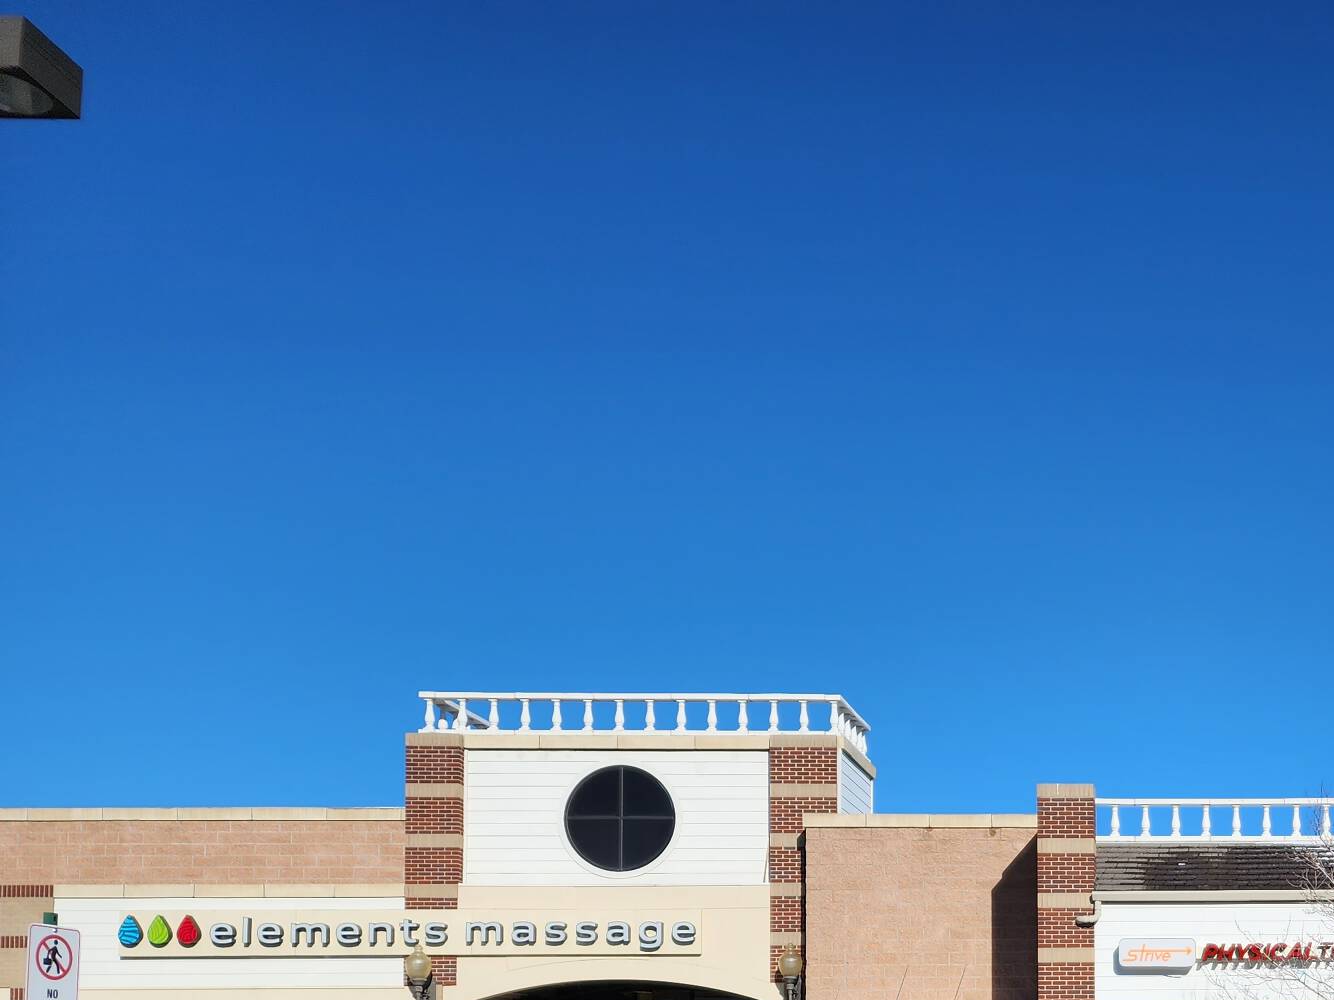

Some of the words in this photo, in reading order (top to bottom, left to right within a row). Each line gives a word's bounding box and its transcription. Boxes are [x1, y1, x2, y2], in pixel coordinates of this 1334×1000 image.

[209, 917, 449, 948] elements
[465, 921, 697, 952] massage
[1122, 944, 1175, 962] strive
[1202, 942, 1318, 961] PHYSICAL
[47, 988, 58, 999] NO
